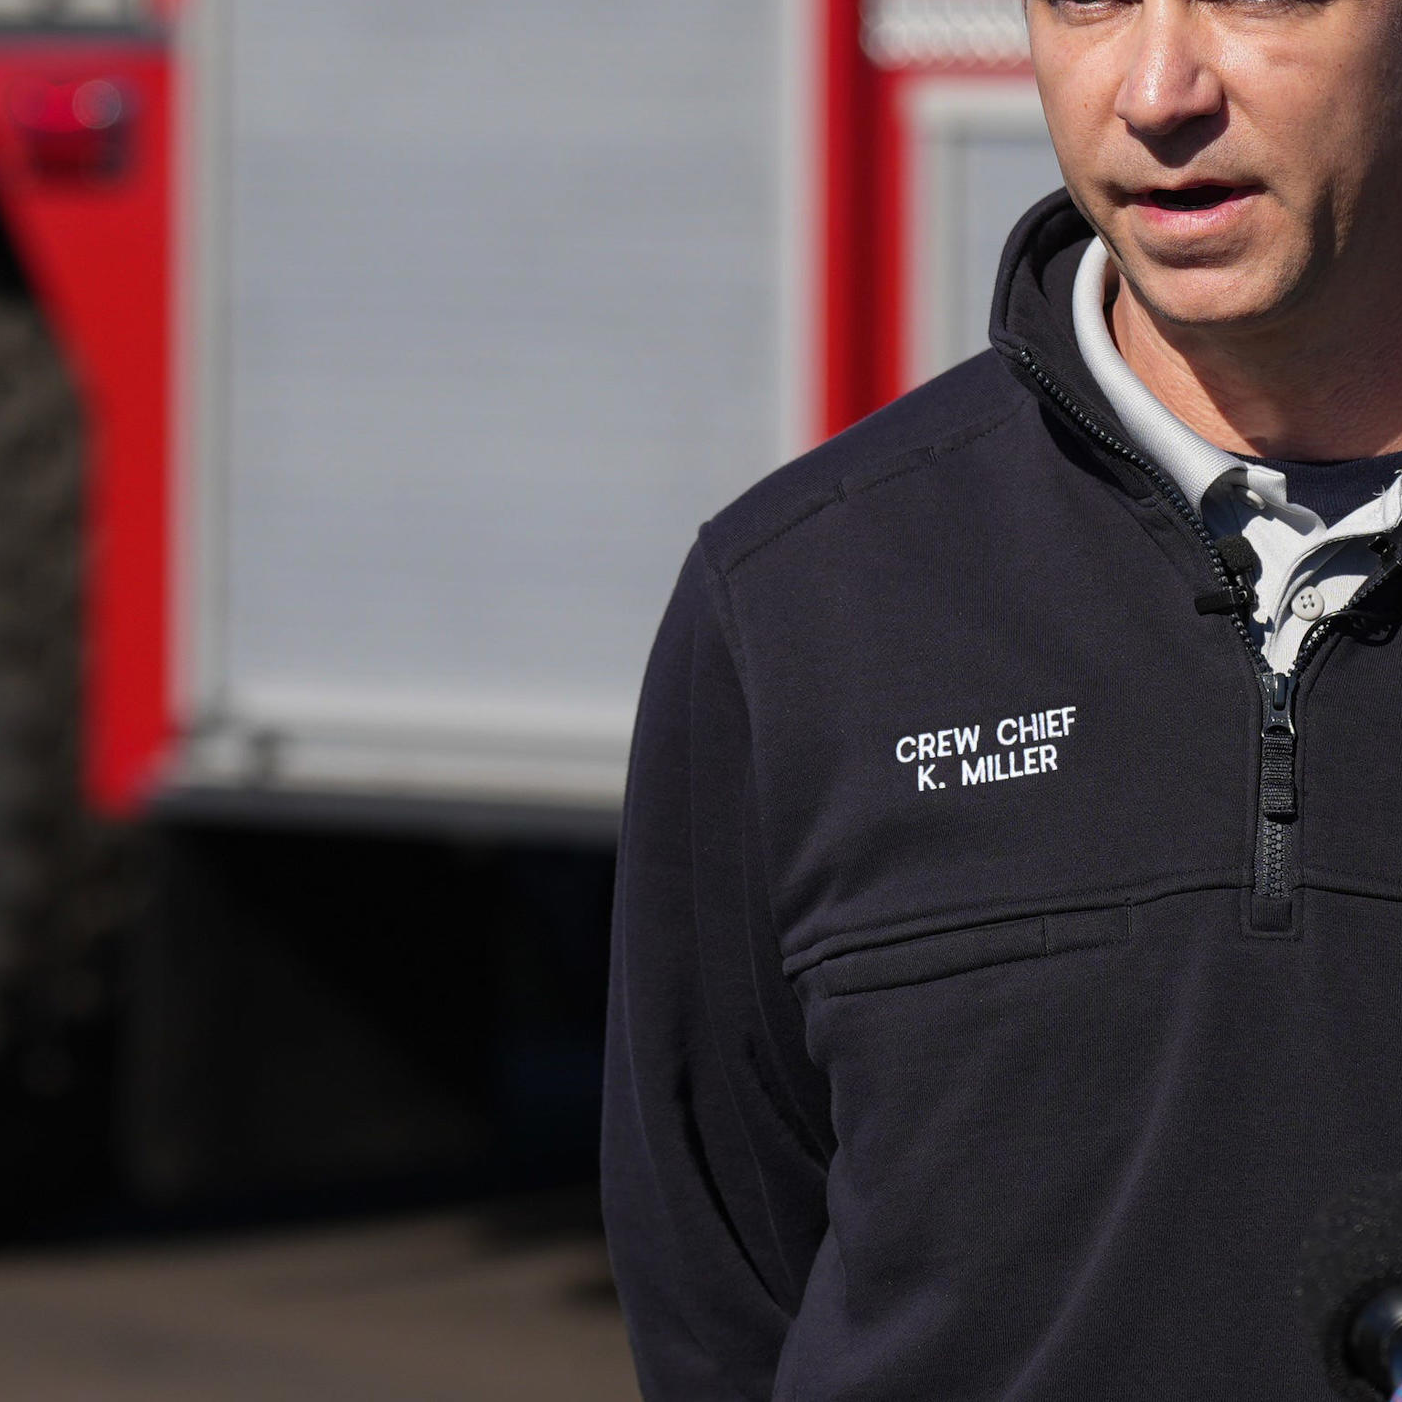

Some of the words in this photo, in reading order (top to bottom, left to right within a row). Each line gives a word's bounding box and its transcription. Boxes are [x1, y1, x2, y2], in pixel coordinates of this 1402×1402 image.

[895, 724, 981, 763] CREW
[996, 705, 1077, 746] CHIEF
[917, 763, 946, 792] K.
[961, 744, 1058, 786] MILLER
